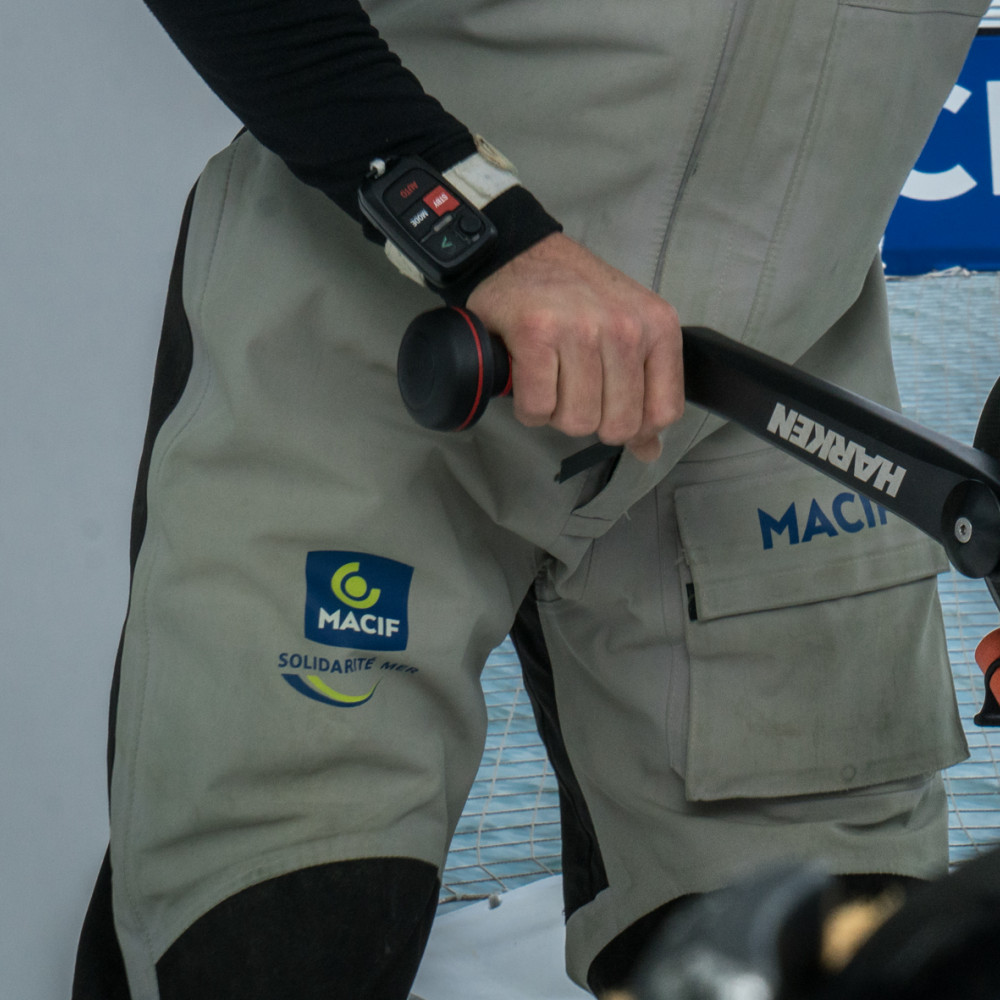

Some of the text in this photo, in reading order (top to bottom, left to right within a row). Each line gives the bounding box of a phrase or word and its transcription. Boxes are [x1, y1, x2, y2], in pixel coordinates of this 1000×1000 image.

[400, 181, 419, 199] AUTO
[410, 208, 429, 228] MODE
[766, 402, 907, 498] HARKEN
[318, 607, 400, 637] MACIF
[278, 653, 420, 675] SOLIDARITÉ MER
